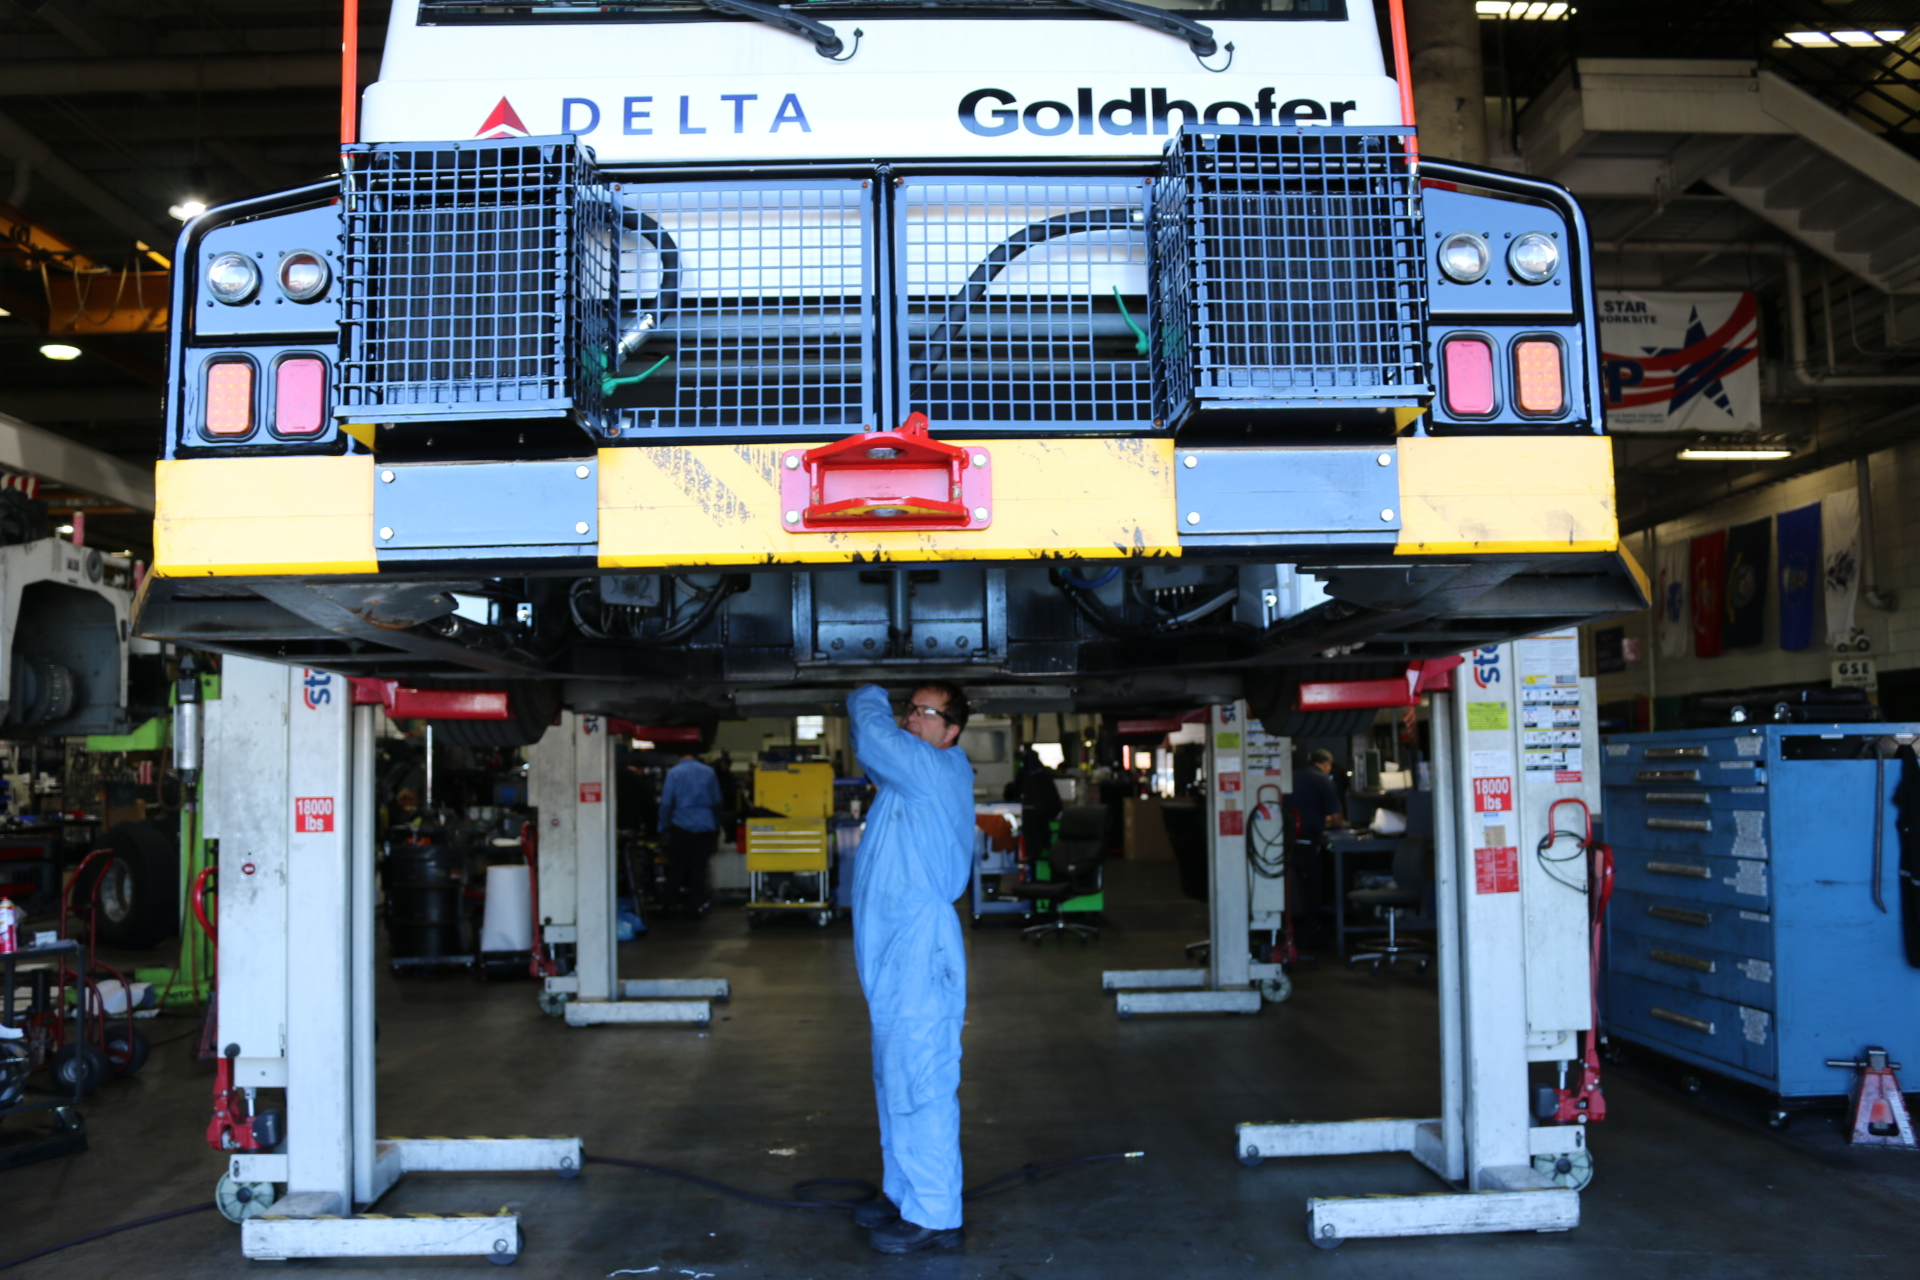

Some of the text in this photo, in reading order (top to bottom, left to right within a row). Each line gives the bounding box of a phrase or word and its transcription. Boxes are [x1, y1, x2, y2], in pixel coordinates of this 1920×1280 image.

[561, 93, 812, 137] DELTA
[957, 87, 1357, 137] Goldhofer
[1603, 300, 1647, 313] STAR
[1474, 778, 1509, 795] 18000
[297, 799, 332, 815] 18000
[1483, 794, 1503, 811] lbs
[305, 815, 324, 831] lbs
